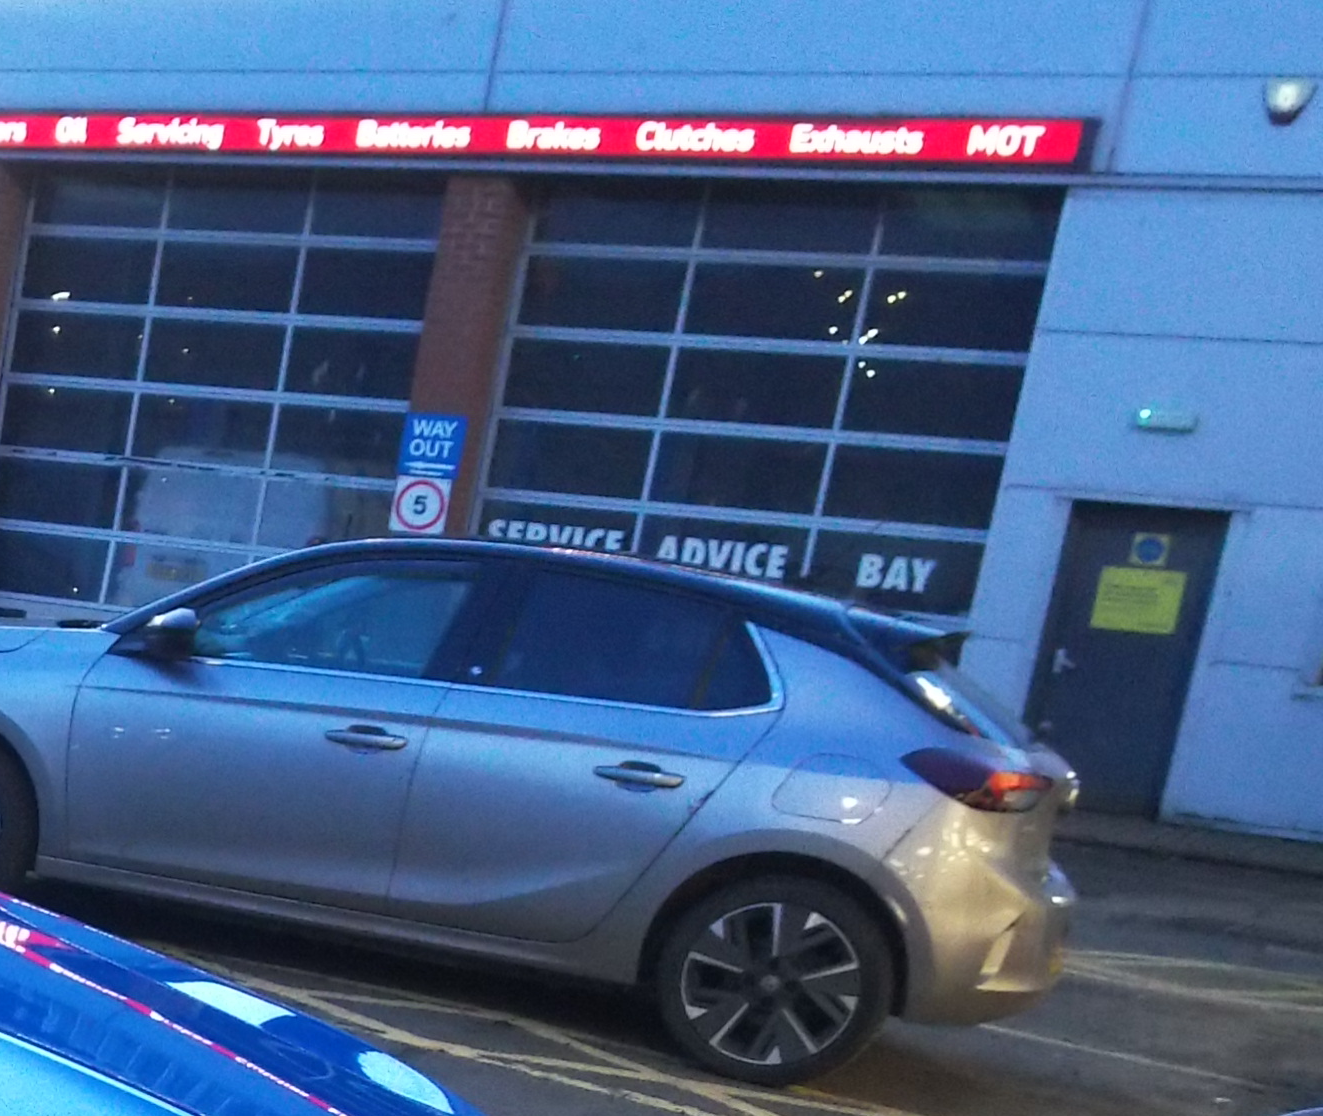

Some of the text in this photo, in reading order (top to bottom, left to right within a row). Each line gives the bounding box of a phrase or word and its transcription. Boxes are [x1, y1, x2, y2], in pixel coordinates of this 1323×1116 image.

[55, 117, 87, 143] Oil
[116, 117, 225, 150] Servicing
[258, 118, 324, 150] Tyres
[356, 119, 471, 148] Batteries
[507, 120, 601, 150] Brakes
[635, 121, 755, 152] Clutches
[789, 123, 924, 154] Exhausts
[967, 125, 1046, 157] MOT
[413, 419, 458, 438] WAY
[409, 439, 454, 458] OUT
[413, 495, 428, 515] 5
[657, 535, 789, 579] ADVICE
[856, 553, 937, 594] BAY
